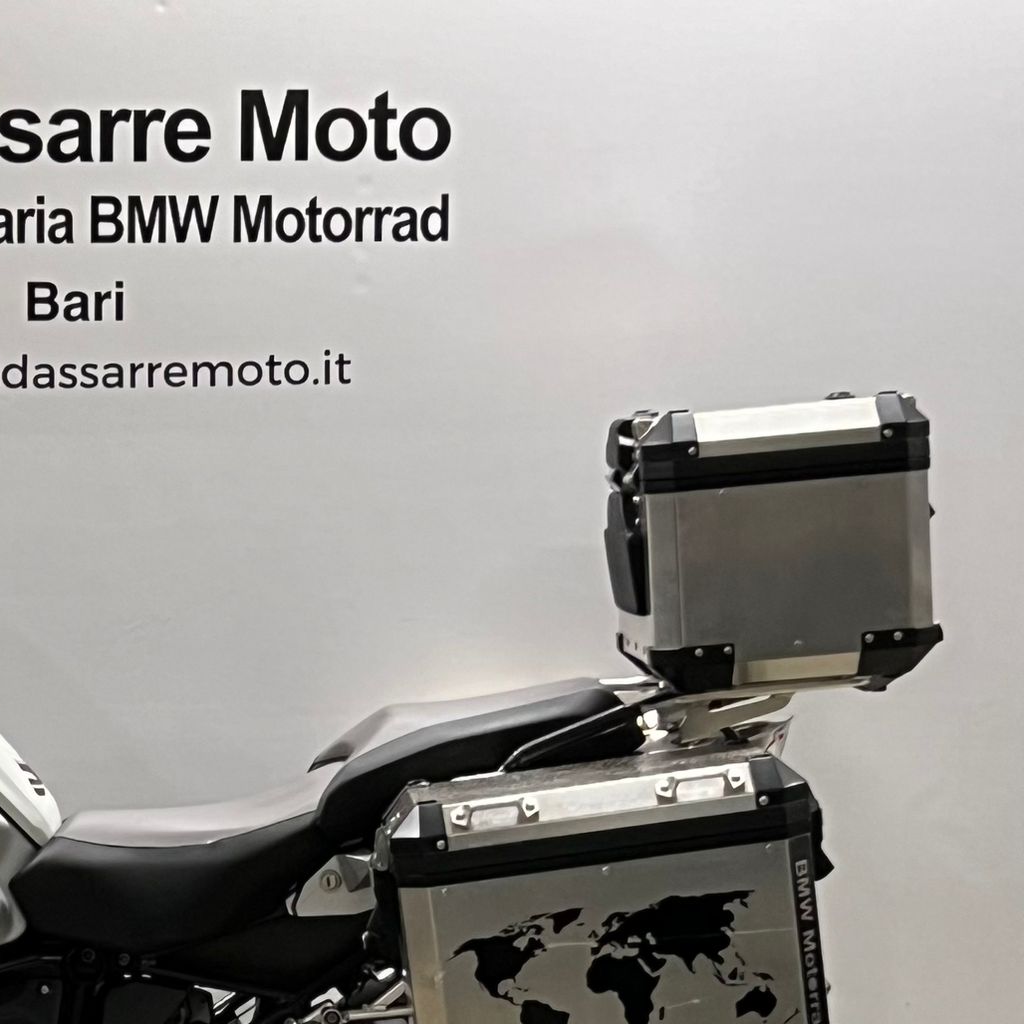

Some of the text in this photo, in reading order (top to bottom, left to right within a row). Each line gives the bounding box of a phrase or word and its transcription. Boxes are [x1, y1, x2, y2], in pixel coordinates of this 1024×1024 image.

[240, 89, 452, 162] Moto
[90, 195, 220, 244] BMW
[233, 193, 449, 243] Motorrad
[27, 280, 124, 322] Bari
[795, 859, 814, 921] BMW
